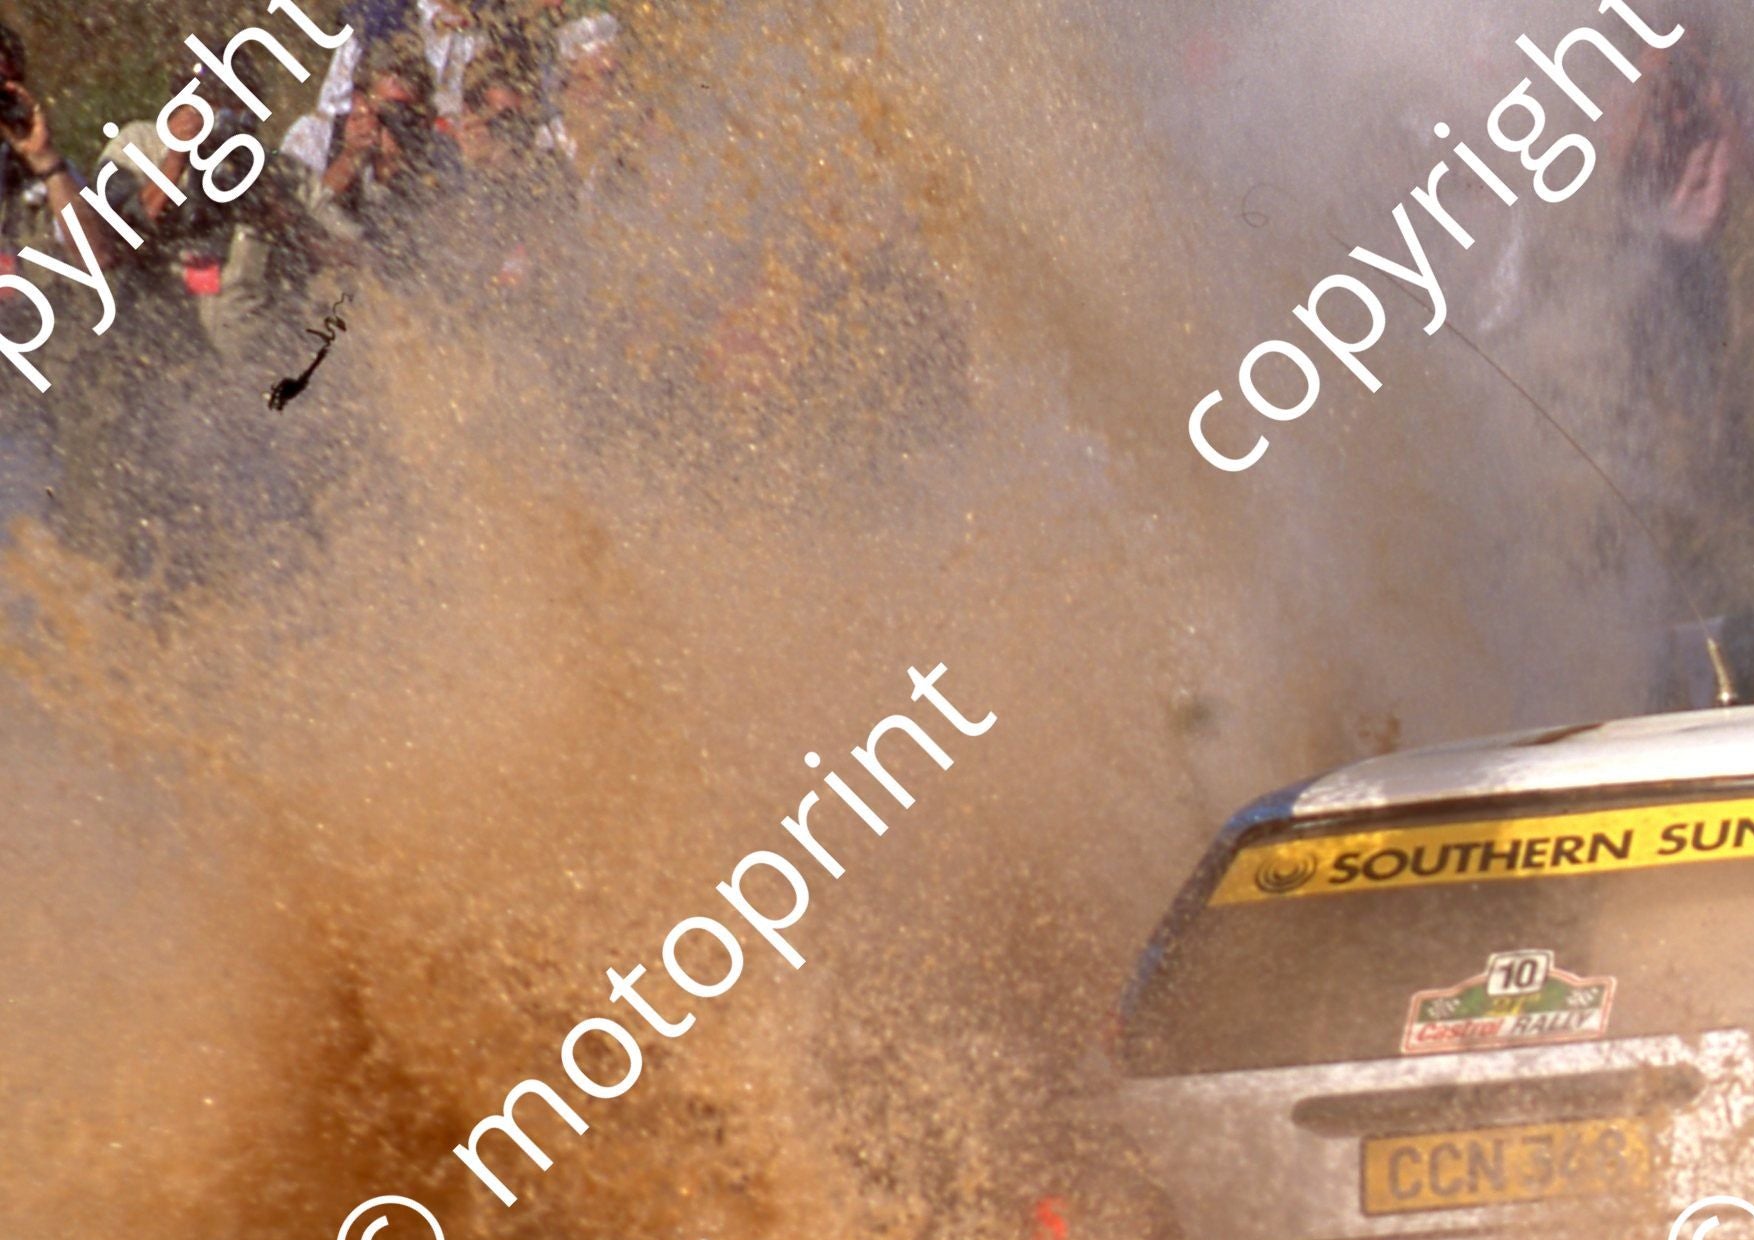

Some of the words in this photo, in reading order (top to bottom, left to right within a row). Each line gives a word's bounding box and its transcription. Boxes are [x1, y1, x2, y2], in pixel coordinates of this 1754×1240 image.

[1329, 829, 1633, 885] SOUTHERN
[1501, 959, 1537, 989] 10
[1510, 1008, 1596, 1035] RALLY
